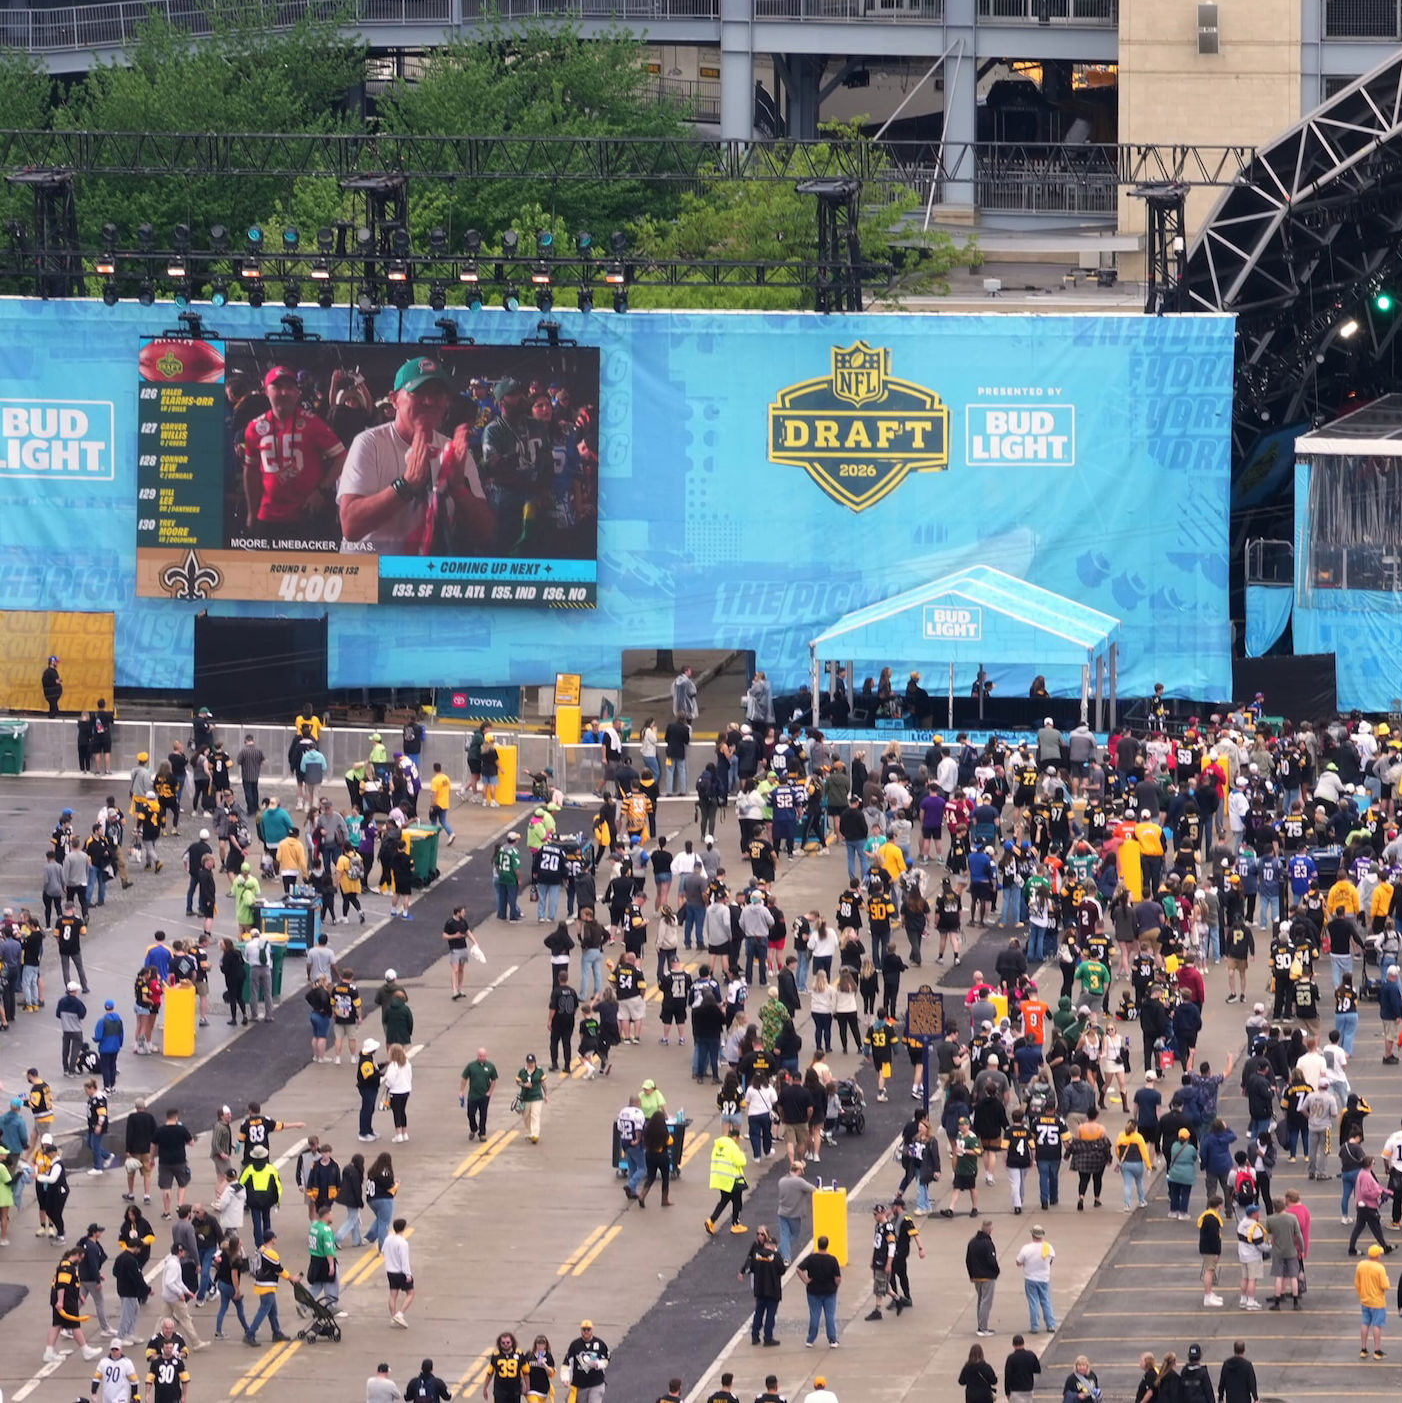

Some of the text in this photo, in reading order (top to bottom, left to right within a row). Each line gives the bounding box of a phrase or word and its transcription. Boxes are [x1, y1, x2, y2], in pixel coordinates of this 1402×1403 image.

[838, 371, 878, 396] NFL
[140, 388, 158, 399] 126
[977, 387, 1062, 396] PRESENTED BY
[2, 408, 88, 438] BUD
[141, 423, 158, 434] 127
[986, 411, 1054, 435] BUD
[783, 420, 932, 448] DRAFT
[972, 436, 1067, 459] LIGHT
[139, 455, 157, 466] 128
[839, 464, 877, 477] 2026
[139, 488, 156, 499] 129
[138, 519, 155, 530] 130
[159, 527, 189, 536] MOORE
[272, 539, 338, 551] LINEBACKER,
[341, 541, 376, 552] TEXAS.
[270, 564, 299, 573] ROUND
[324, 566, 343, 574] PICK
[345, 566, 359, 575] 132
[440, 561, 541, 575] COMING UP NEXT
[278, 574, 343, 602] 4:00
[392, 583, 415, 597] 133.
[417, 584, 434, 597] SF
[440, 584, 463, 598] 134.
[464, 585, 485, 598] ATL
[490, 585, 513, 599] 135.
[515, 586, 537, 600] IND
[568, 587, 587, 601] NO
[933, 609, 972, 623] BUD
[926, 623, 977, 637] LIGHT
[469, 697, 503, 708] TOYOTA
[541, 854, 559, 870] 20
[250, 1126, 264, 1141] 83
[1037, 1125, 1058, 1144] 75
[106, 1367, 120, 1383] 90
[159, 1366, 174, 1383] 30
[500, 1360, 516, 1376] 39
